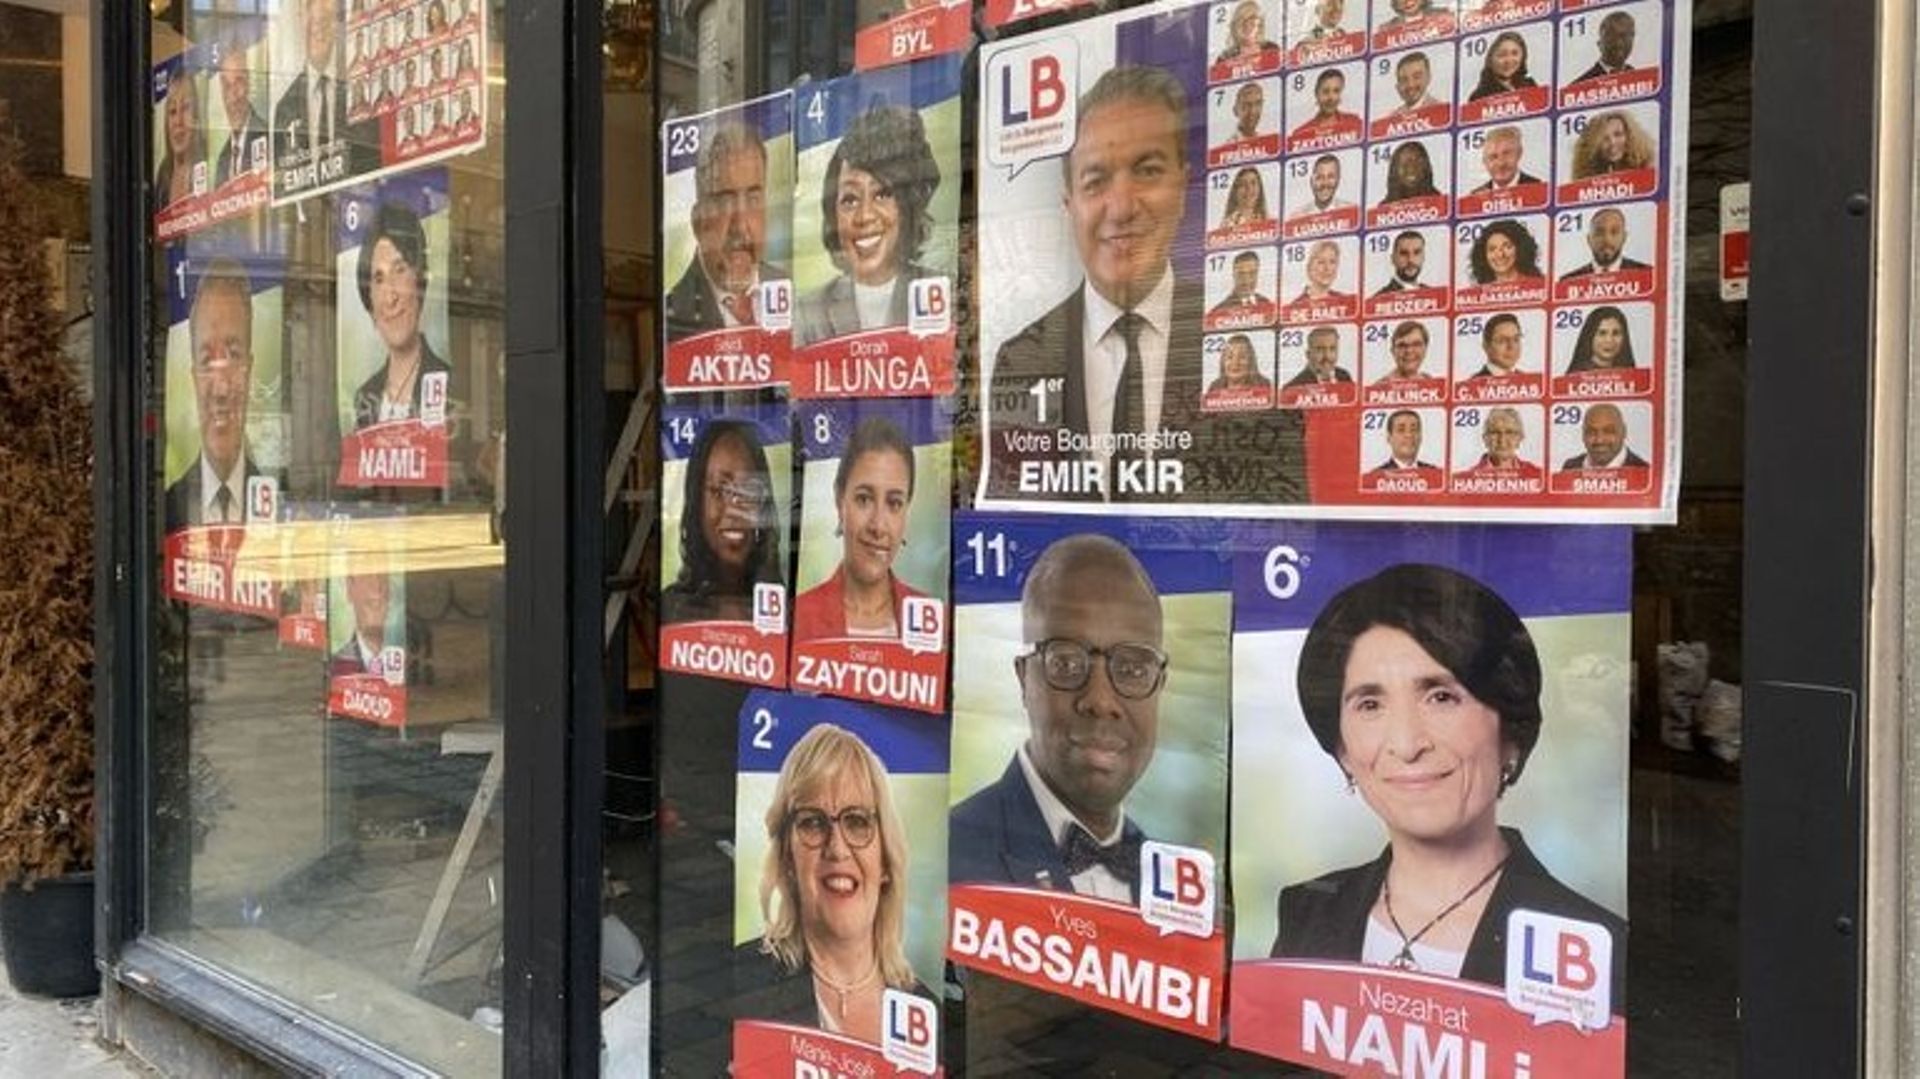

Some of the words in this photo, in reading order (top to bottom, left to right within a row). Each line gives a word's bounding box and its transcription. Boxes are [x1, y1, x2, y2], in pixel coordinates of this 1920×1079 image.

[1216, 7, 1226, 23] 2
[1565, 18, 1587, 38] 11
[892, 29, 934, 58] BYL
[1464, 38, 1487, 57] 10
[1379, 59, 1391, 76] 9
[1002, 55, 1067, 127] LB
[1293, 74, 1306, 91] 8
[1563, 80, 1654, 107] BASSAMBI
[1481, 101, 1527, 119] MARA
[1562, 115, 1587, 135] 16
[671, 128, 700, 157] 23
[1462, 132, 1485, 150] 15
[1372, 147, 1391, 164] 14
[1289, 160, 1309, 178] 13
[1211, 173, 1230, 189] 12
[1578, 183, 1635, 202] MHADI
[1559, 214, 1583, 232] 21
[1368, 236, 1390, 252] 19
[1208, 256, 1227, 271] 17
[765, 284, 789, 315] LB
[915, 286, 947, 318] LB
[1457, 317, 1483, 336] 25
[1556, 310, 1583, 329] 26
[1204, 336, 1225, 353] 22
[1282, 331, 1303, 348] 23
[1366, 325, 1389, 342] 24
[688, 353, 771, 382] AKTAS
[814, 357, 931, 394] ILUNGA
[1029, 378, 1065, 422] 1er
[1365, 412, 1387, 429] 27
[1455, 409, 1480, 427] 28
[1554, 406, 1582, 425] 29
[814, 413, 830, 443] 8
[1004, 429, 1052, 453] Votre
[1057, 426, 1193, 458] Bourgmestre
[1018, 459, 1105, 492] EMIR
[1117, 460, 1185, 493] KIR
[1452, 477, 1541, 493] HARDENNE
[250, 480, 272, 518] LB
[173, 557, 225, 602] EMIR
[232, 564, 275, 609] KIR
[758, 589, 782, 617] LB
[908, 603, 939, 635] LB
[671, 640, 774, 681] NGONGO
[796, 655, 937, 706] ZAYTOUNI
[1152, 851, 1207, 906] LB
[1050, 904, 1098, 939] Yves
[951, 910, 1211, 1027] BASSAMBI
[1522, 925, 1597, 992] LB
[1359, 981, 1469, 1033] Nezahat
[889, 997, 930, 1047] LB
